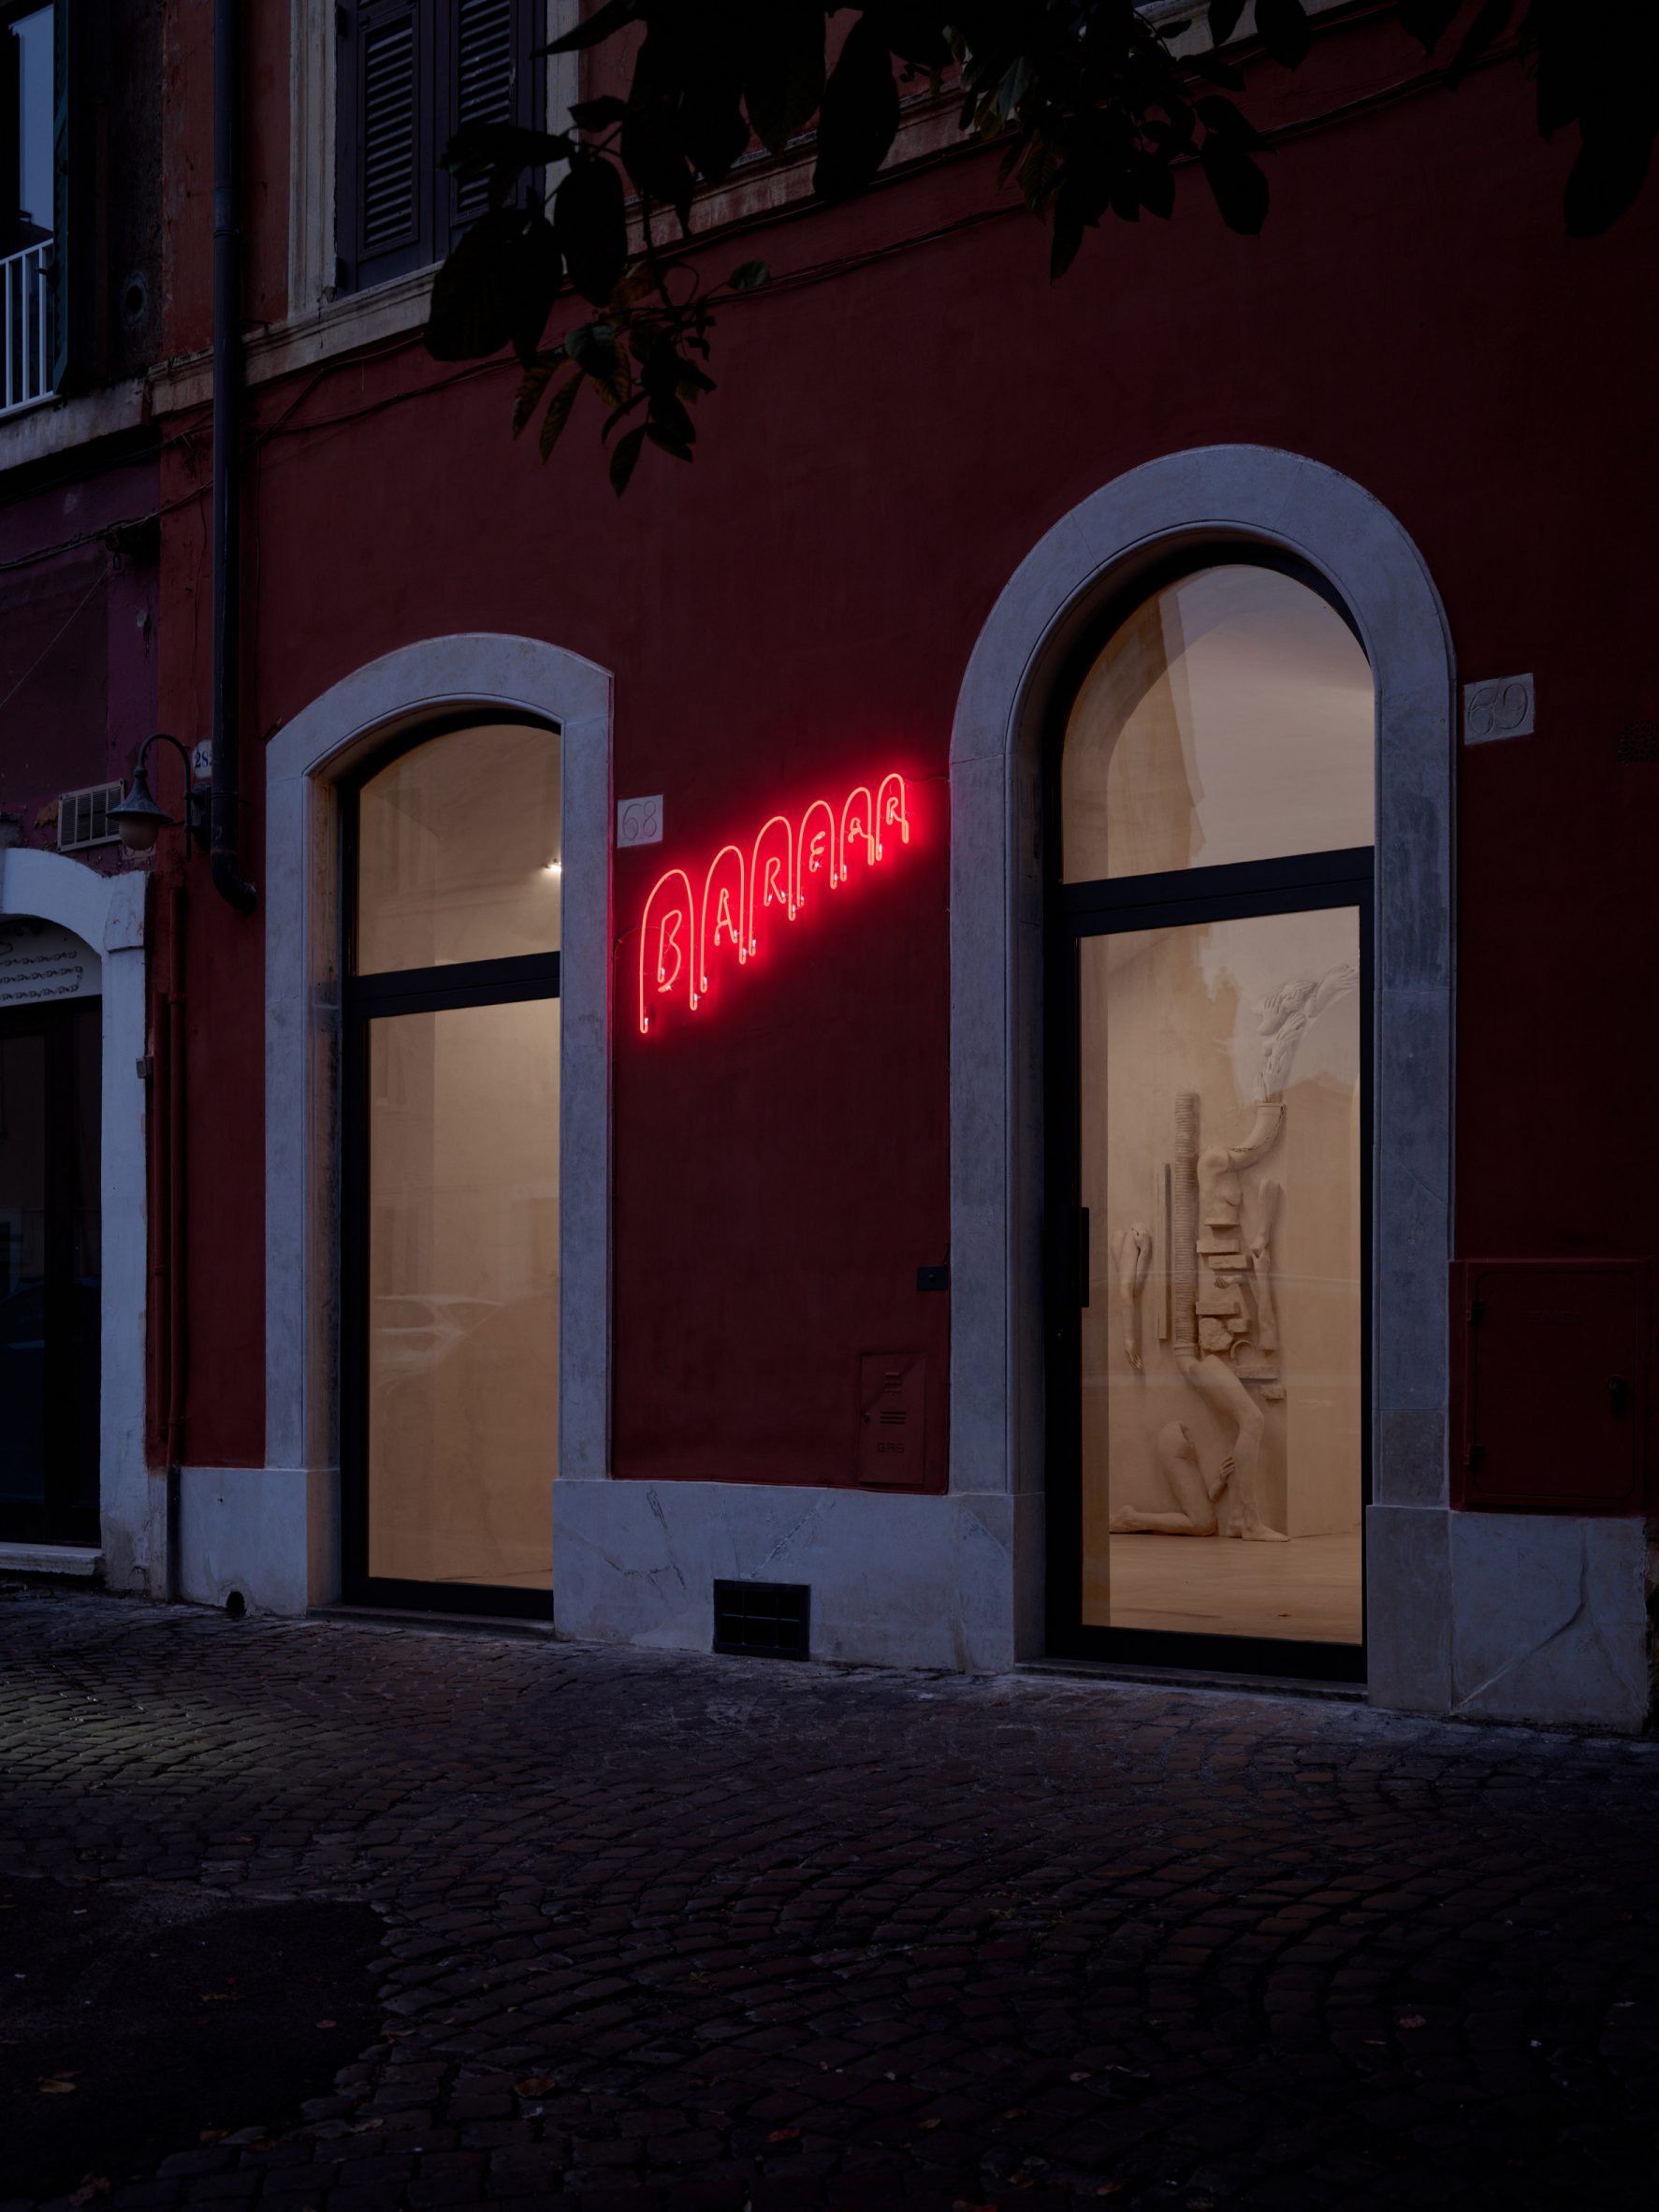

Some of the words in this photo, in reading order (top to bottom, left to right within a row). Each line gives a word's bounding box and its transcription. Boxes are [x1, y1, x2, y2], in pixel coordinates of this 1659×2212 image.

[1467, 682, 1528, 735] 69
[621, 800, 658, 840] 68
[877, 1442, 905, 1453] GAS
